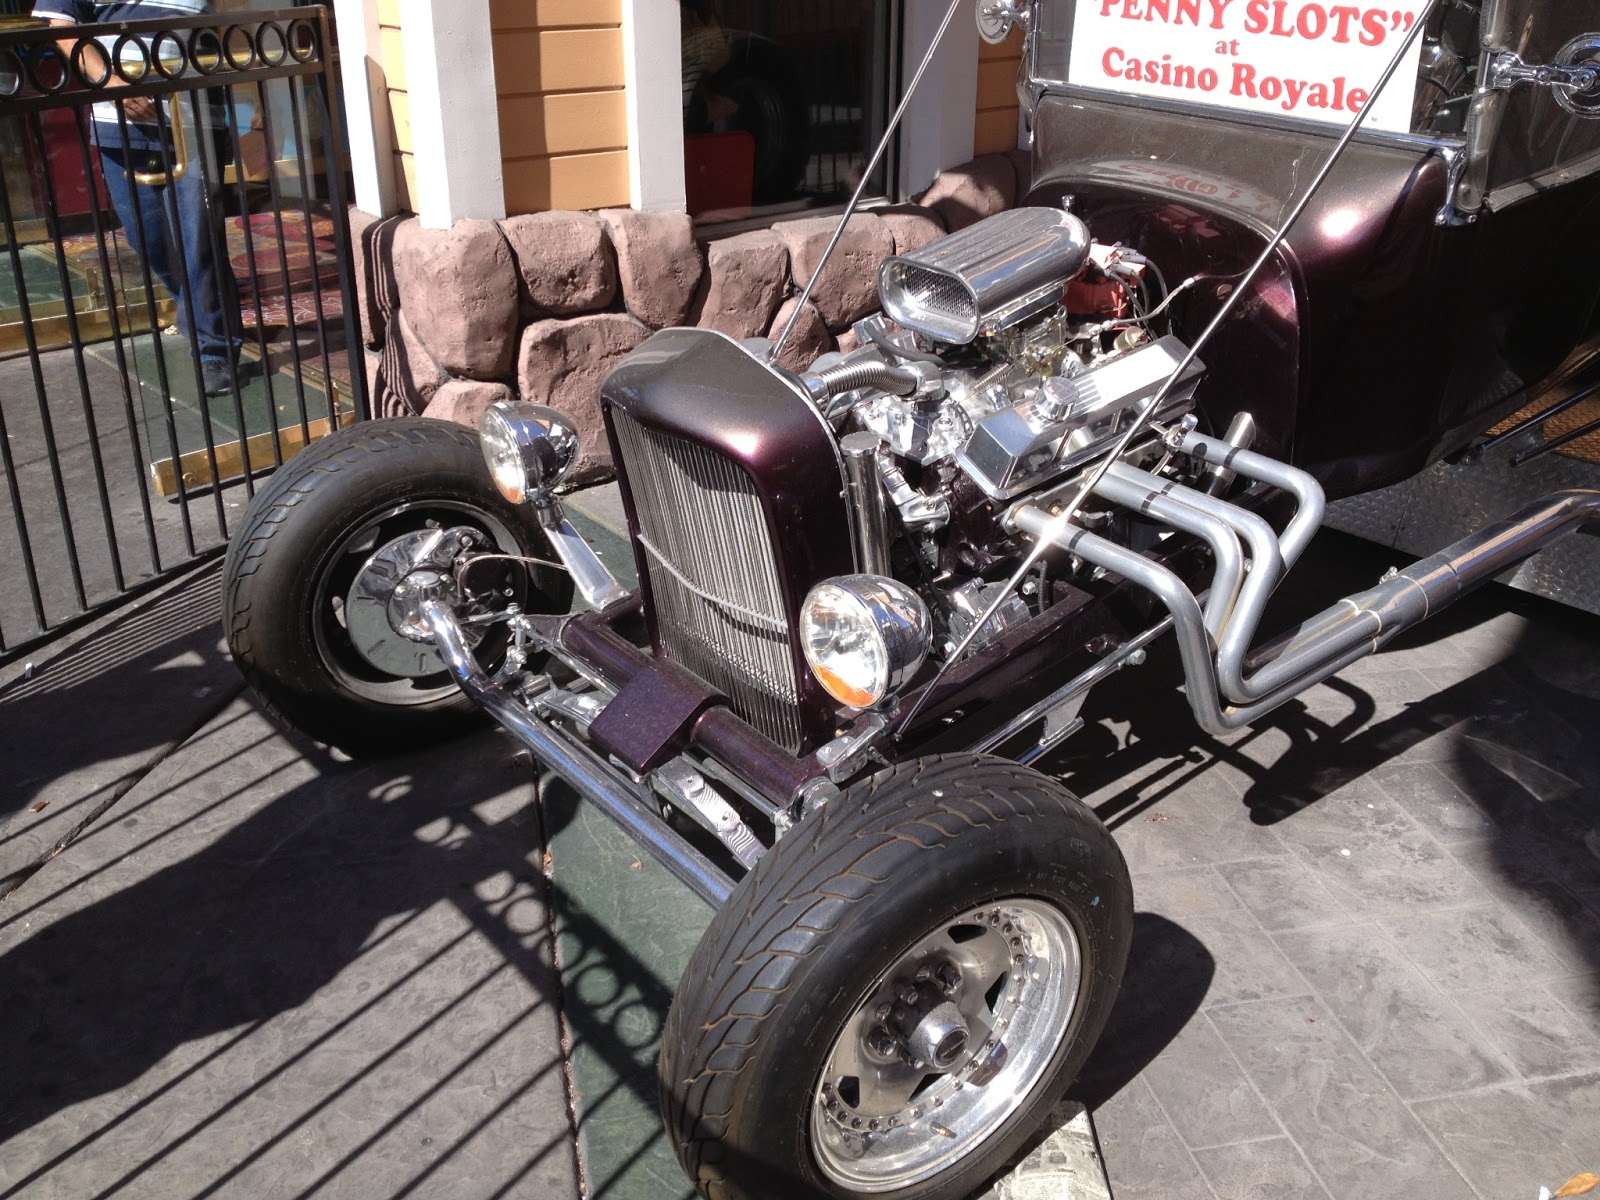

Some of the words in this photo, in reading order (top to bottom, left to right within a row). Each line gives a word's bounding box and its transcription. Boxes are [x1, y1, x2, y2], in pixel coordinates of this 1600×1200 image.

[1095, 0, 1232, 30] PENNY
[1215, 39, 1240, 57] at
[1101, 46, 1219, 92] Casino
[1229, 62, 1370, 114] Royale
